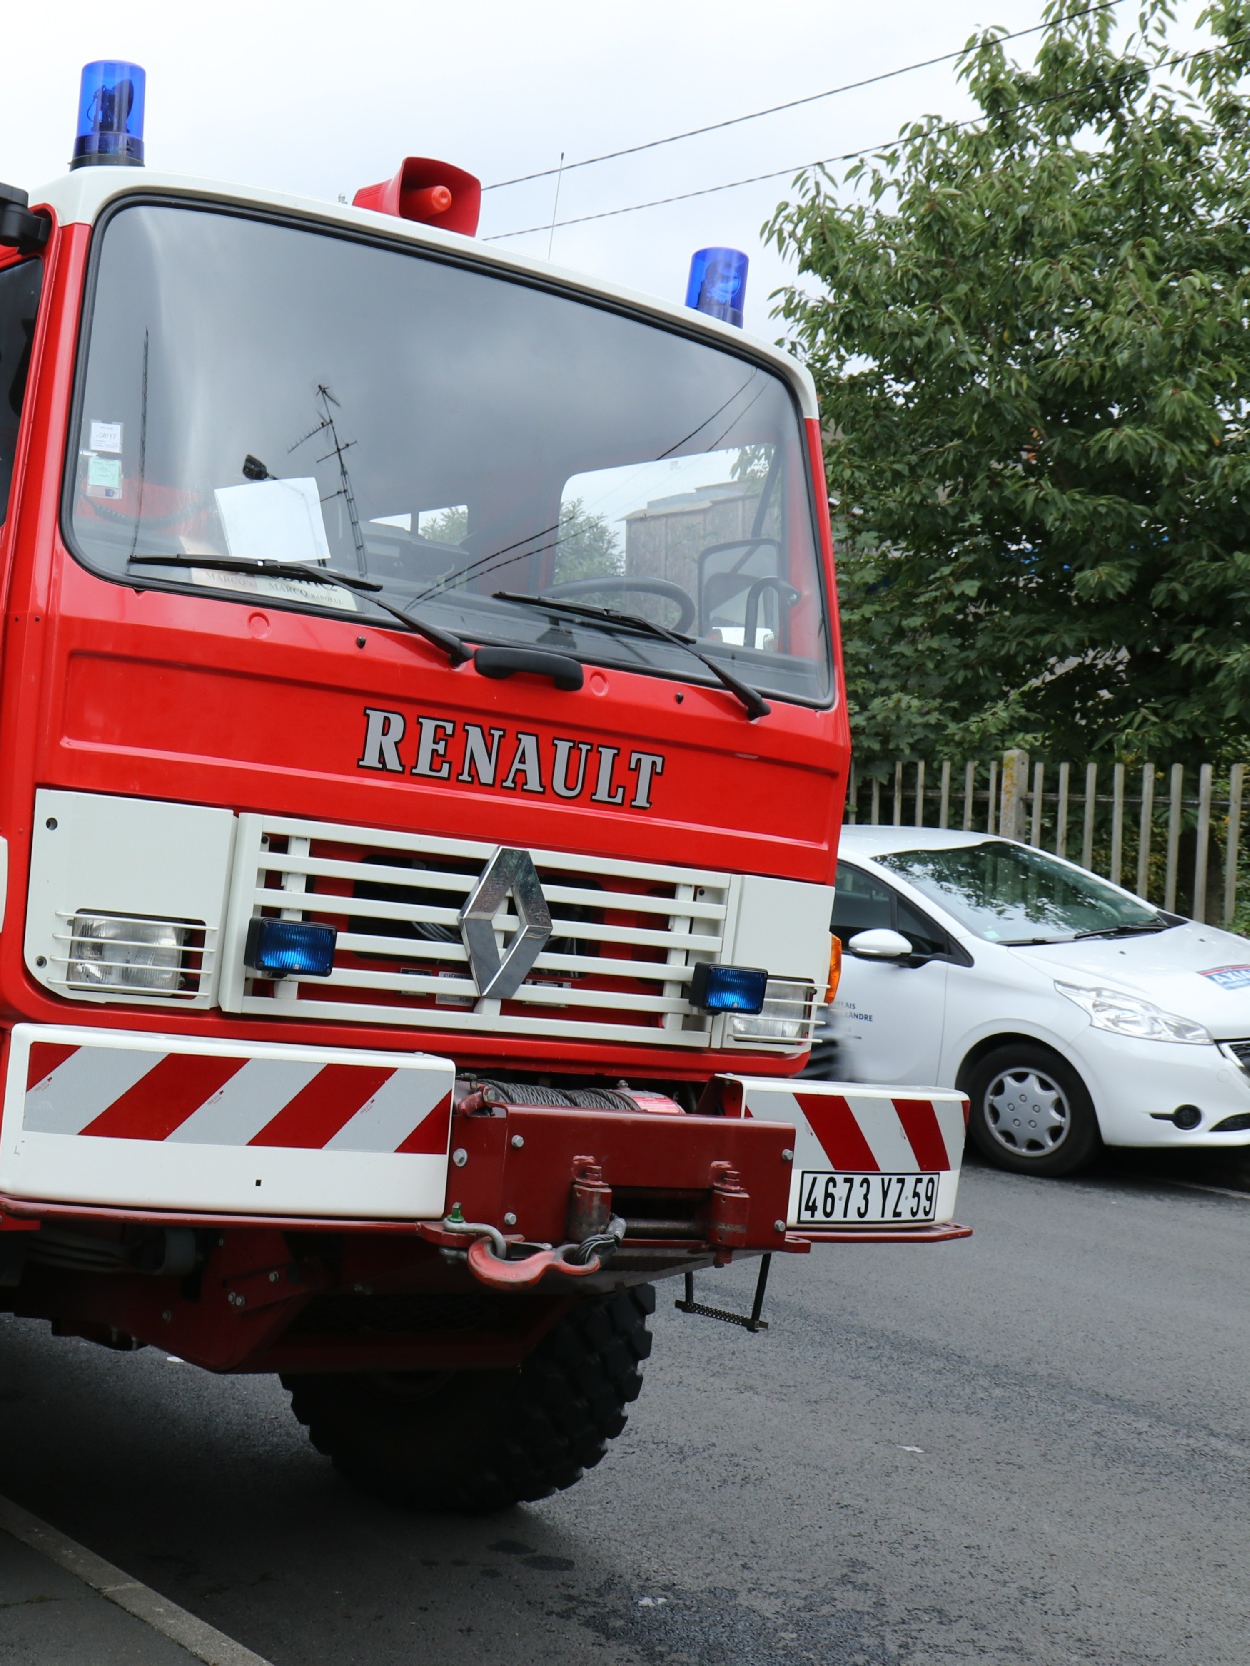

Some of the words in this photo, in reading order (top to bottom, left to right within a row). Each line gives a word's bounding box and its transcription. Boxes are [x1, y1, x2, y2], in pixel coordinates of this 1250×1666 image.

[357, 706, 664, 809] RENAULT
[804, 1176, 871, 1218] 4673
[880, 1177, 906, 1218] YZ
[910, 1177, 936, 1217] 59
